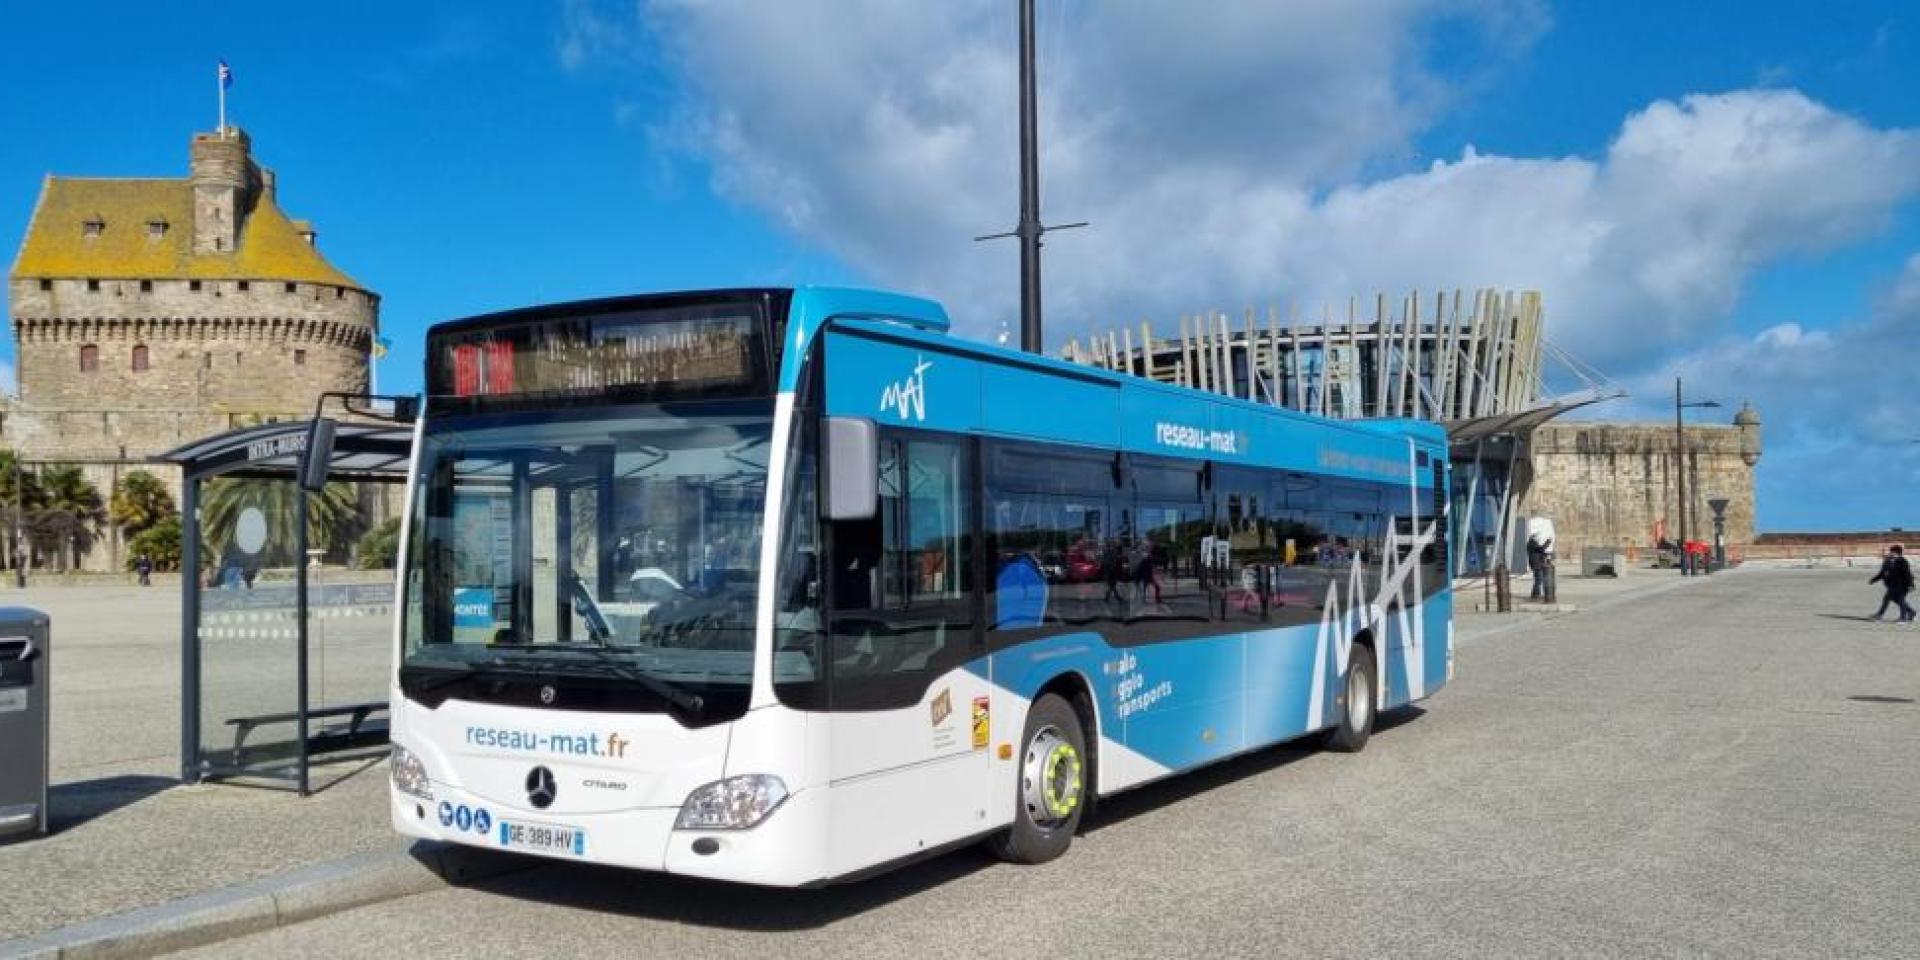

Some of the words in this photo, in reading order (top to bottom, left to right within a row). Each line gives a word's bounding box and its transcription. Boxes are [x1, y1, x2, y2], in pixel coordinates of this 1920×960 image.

[880, 354, 934, 421] MAT
[247, 432, 308, 461] INTRA-MURO
[1156, 421, 1249, 455] reseau-mat
[1114, 680, 1173, 719] ransports
[466, 726, 630, 758] reseau-mat.fr
